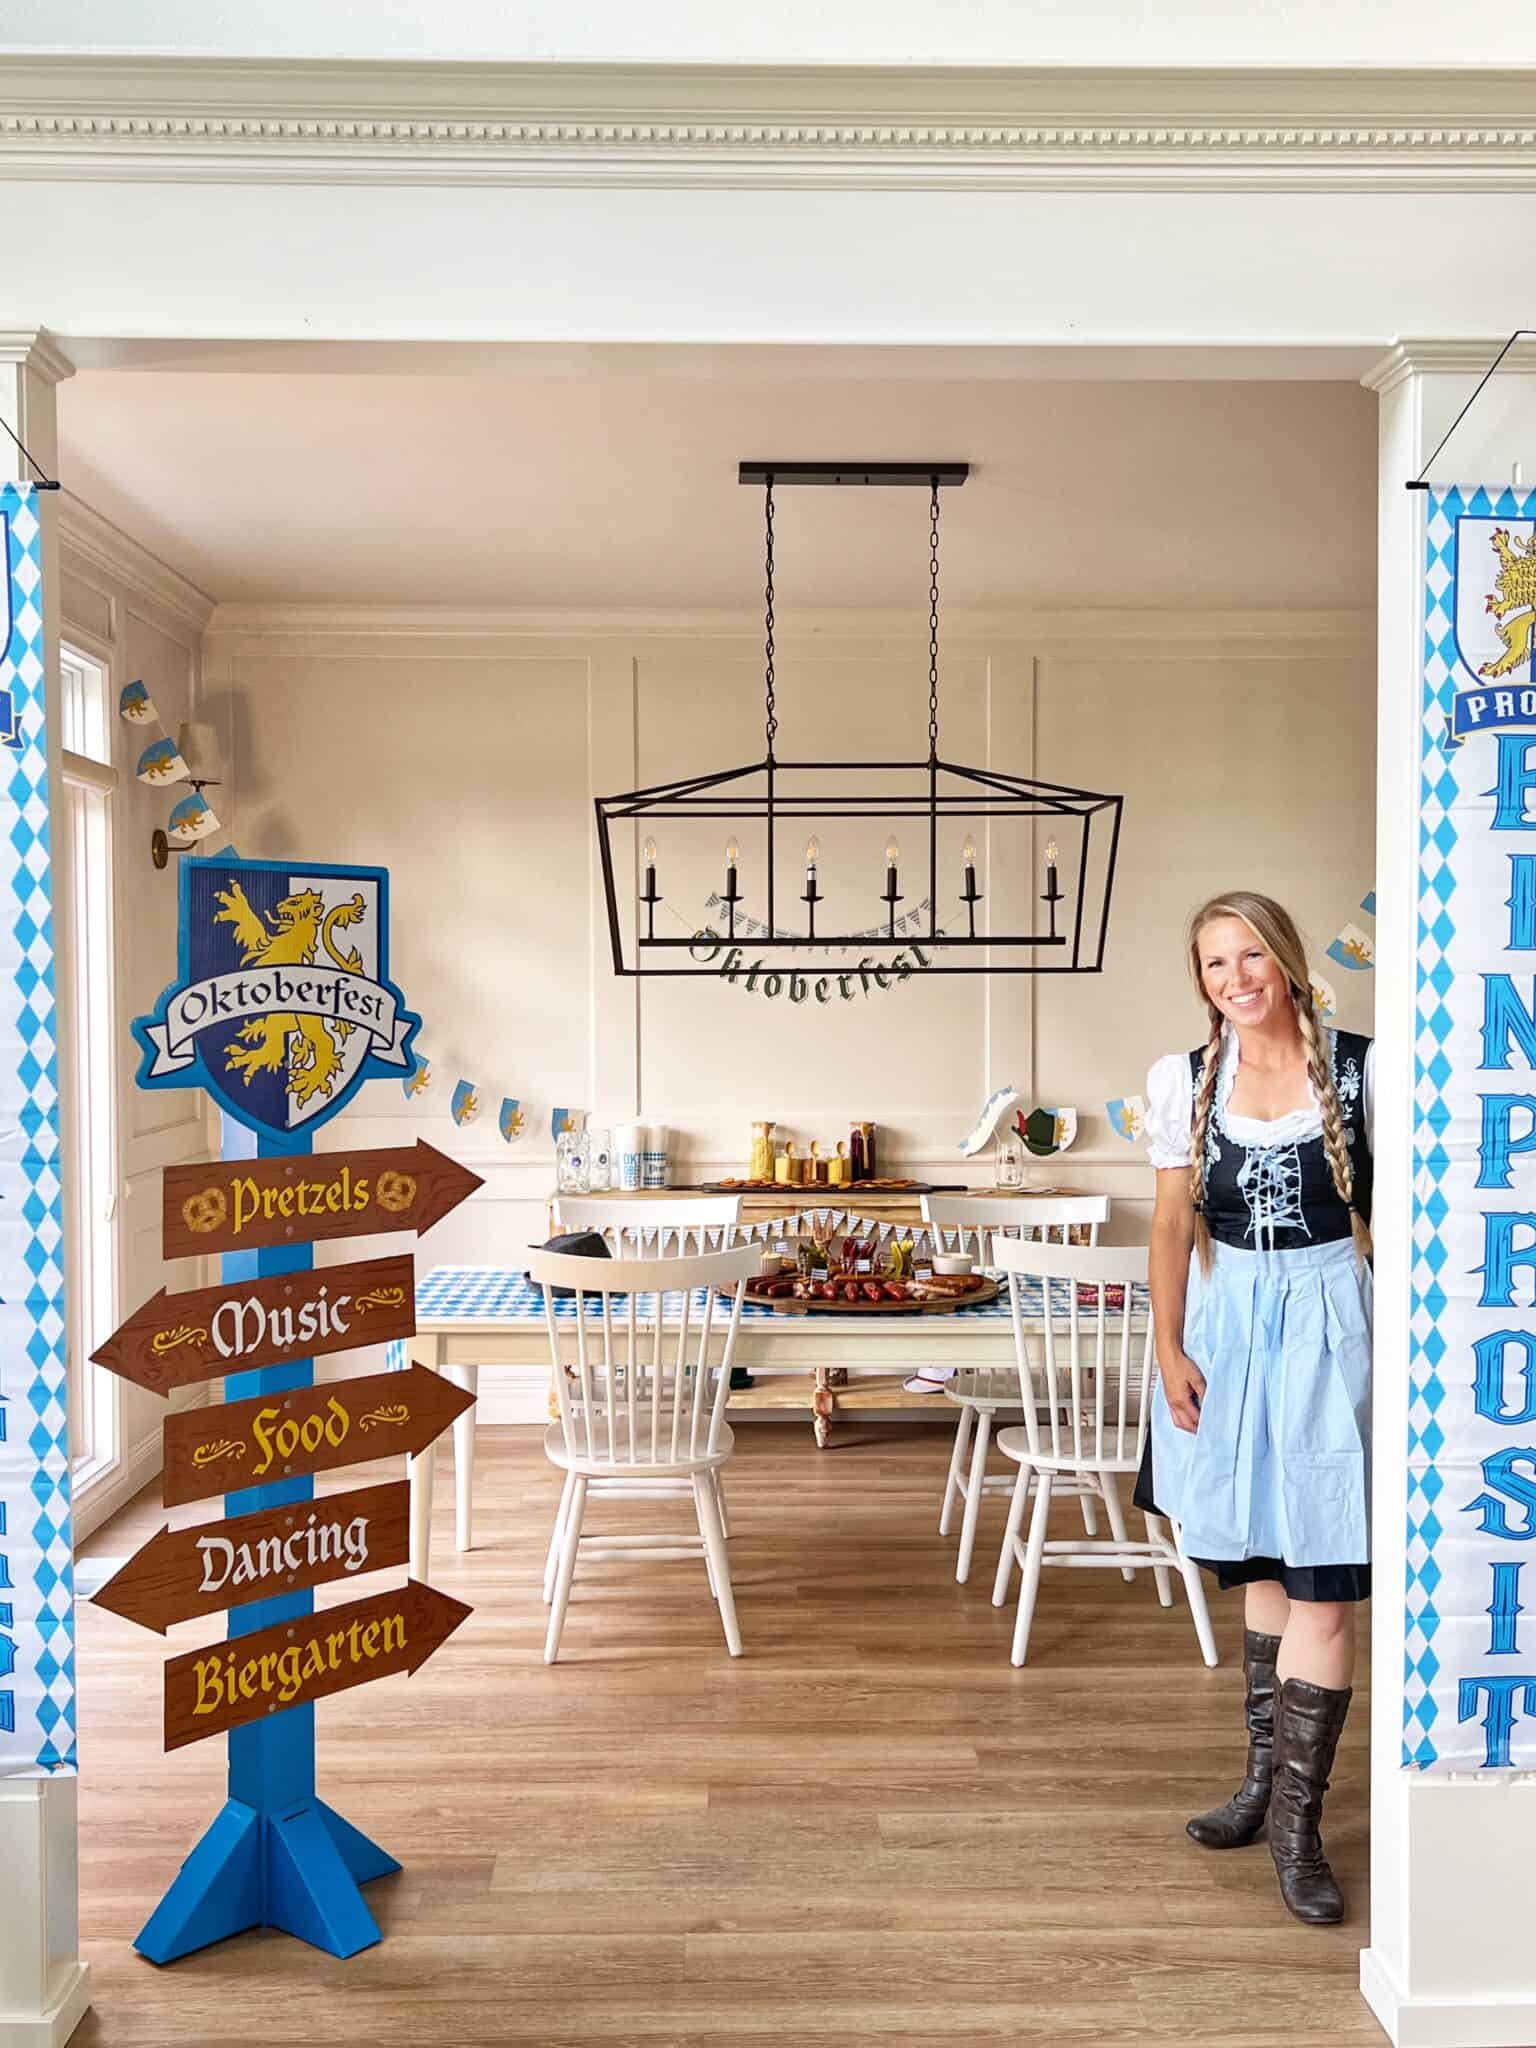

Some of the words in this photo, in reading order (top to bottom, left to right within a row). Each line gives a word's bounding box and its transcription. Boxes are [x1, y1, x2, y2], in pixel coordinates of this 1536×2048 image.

[180, 971, 385, 1026] Oktoberfest
[230, 1166, 370, 1234] Pretzels
[210, 1285, 352, 1358] Music
[251, 1396, 350, 1476] Food
[195, 1513, 370, 1593] Dancing
[192, 1613, 408, 1716] Biergarten
